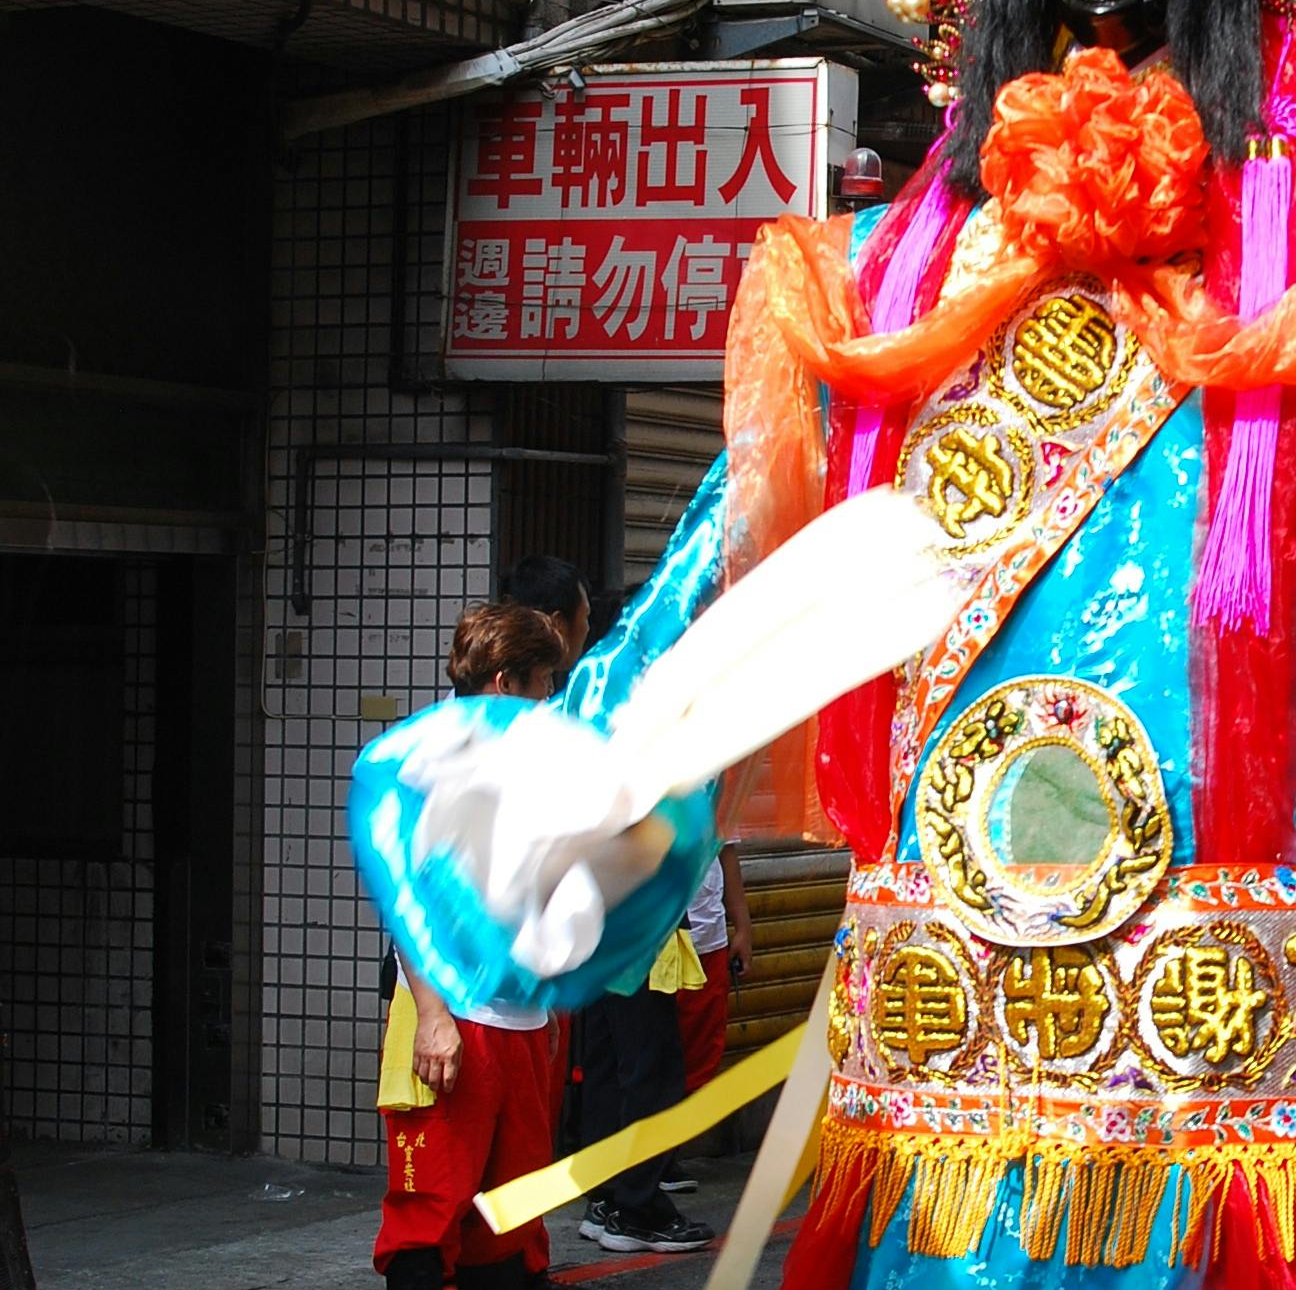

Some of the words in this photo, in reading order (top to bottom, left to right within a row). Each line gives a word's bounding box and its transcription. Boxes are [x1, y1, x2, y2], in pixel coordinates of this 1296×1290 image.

[466, 86, 799, 210] 車輛出入
[452, 238, 510, 341] 週邊
[519, 233, 753, 341] 請勿停
